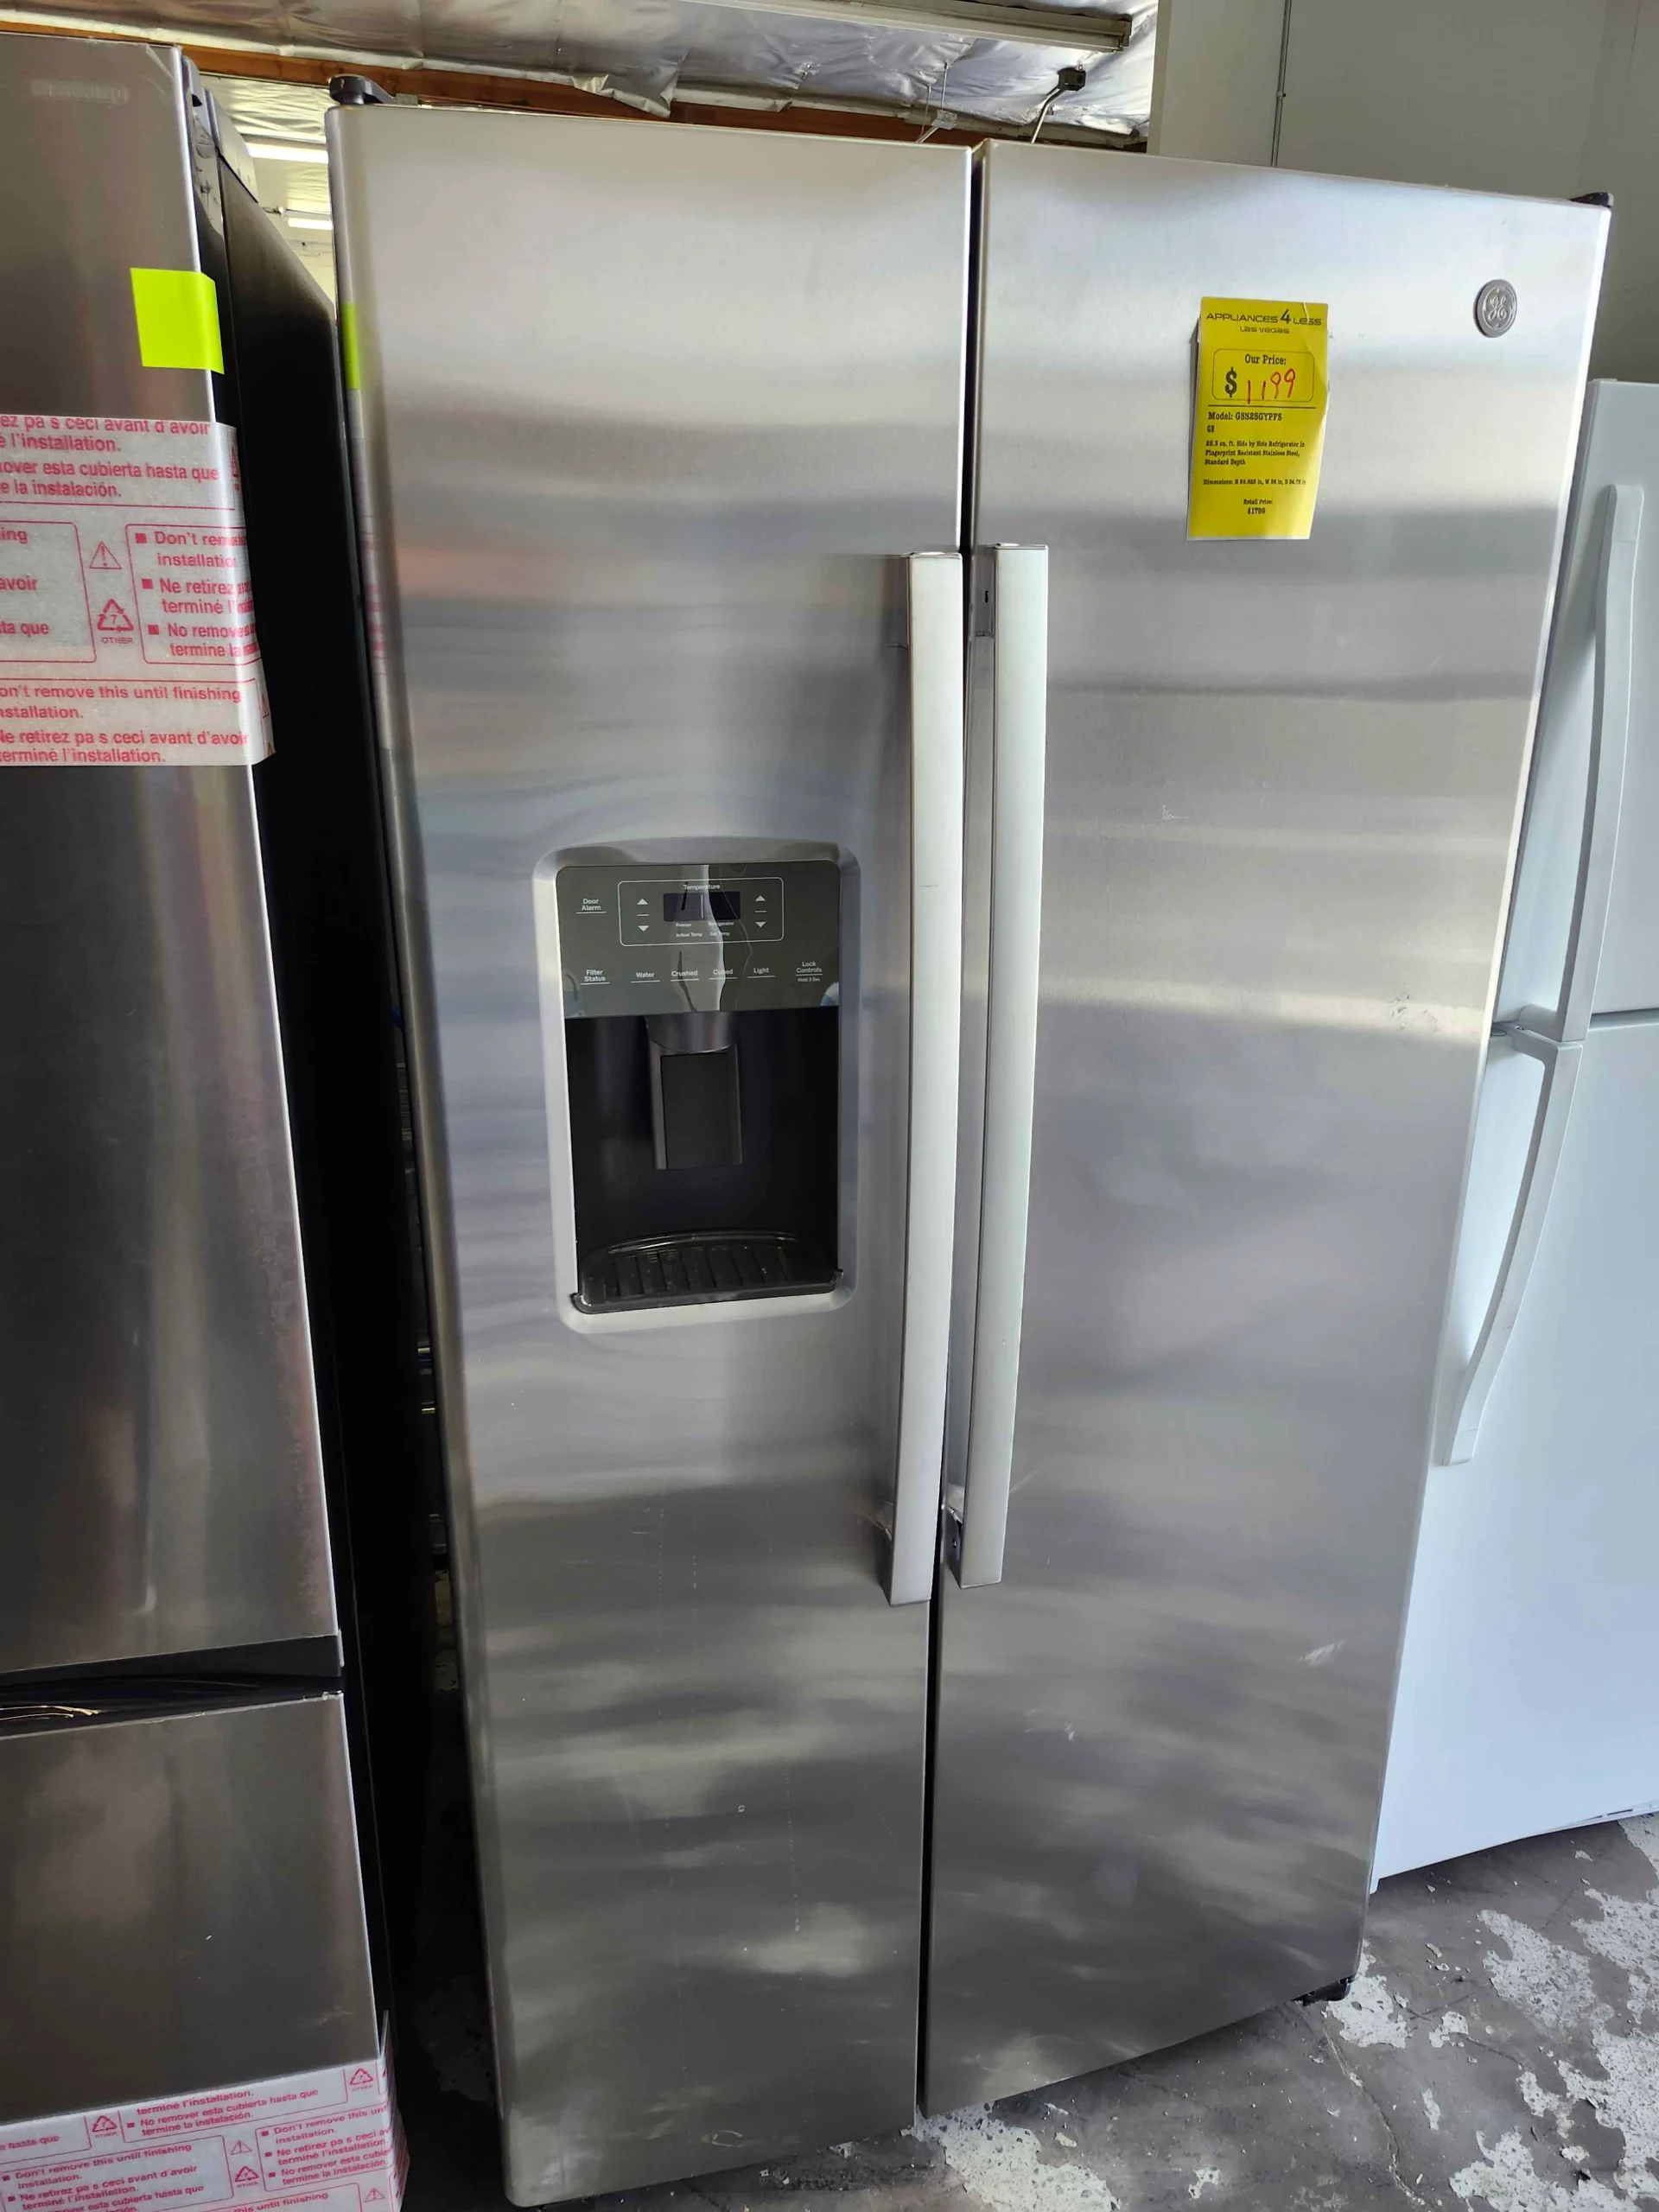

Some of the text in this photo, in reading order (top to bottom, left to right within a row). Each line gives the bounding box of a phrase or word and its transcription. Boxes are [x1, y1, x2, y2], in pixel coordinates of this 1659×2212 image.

[1206, 313, 1278, 323] APPLIANCES
[1281, 309, 1291, 324] 4
[1245, 353, 1287, 365] Our Price:
[1224, 366, 1296, 405] $ 1199
[1208, 411, 1234, 420] Model:
[24, 416, 45, 432] pa
[50, 416, 60, 429] s
[65, 417, 99, 431] ceci
[105, 419, 150, 433] avant
[10, 432, 121, 452] l'installation.
[0, 461, 220, 483] over esta cubierta hasta que
[14, 479, 28, 494] la
[32, 479, 121, 498] instalación.
[0, 527, 29, 544] ing
[154, 531, 198, 545] Don't
[156, 552, 238, 568] installatio
[159, 577, 181, 594] Ne
[186, 579, 234, 594] retirez
[0, 620, 49, 638] ta que
[167, 622, 188, 638] No
[169, 642, 226, 658] termine
[34, 686, 95, 698] remove
[99, 685, 129, 698] this
[133, 686, 168, 699] until
[173, 686, 242, 704] finishing
[19, 729, 71, 744] retirez
[74, 732, 94, 747] pa
[99, 733, 109, 744] s
[112, 730, 145, 744] ceci
[149, 731, 194, 745] avant
[62, 747, 166, 763] l'installation.
[683, 883, 721, 892] Temperature
[182, 2089, 254, 2108] l'installation.
[140, 2088, 319, 2127] No remover esta cubierta hasta que
[142, 2124, 181, 2137] termine
[183, 2120, 193, 2130] la
[274, 2109, 368, 2135] Don't remove this
[8, 2134, 60, 2150] hasta que
[276, 2129, 338, 2145] installation.
[276, 2148, 291, 2158] Ne
[294, 2141, 328, 2153] retirez
[330, 2139, 344, 2150] pa
[355, 2130, 377, 2142] ceci
[16, 2144, 192, 2180] Don't remove this until finishing
[281, 2155, 361, 2177] No remover esta
[17, 2173, 83, 2190] installation.
[20, 2192, 36, 2202] Ne
[38, 2186, 73, 2199] retirez
[102, 2177, 125, 2189] ceci
[127, 2171, 158, 2183] avant
[282, 2173, 320, 2185] termine
[111, 2194, 153, 2208] cubierta
[155, 2188, 183, 2199] hasta
[185, 2184, 205, 2196] que
[257, 2201, 281, 2211] until
[283, 2192, 328, 2206] finishing
